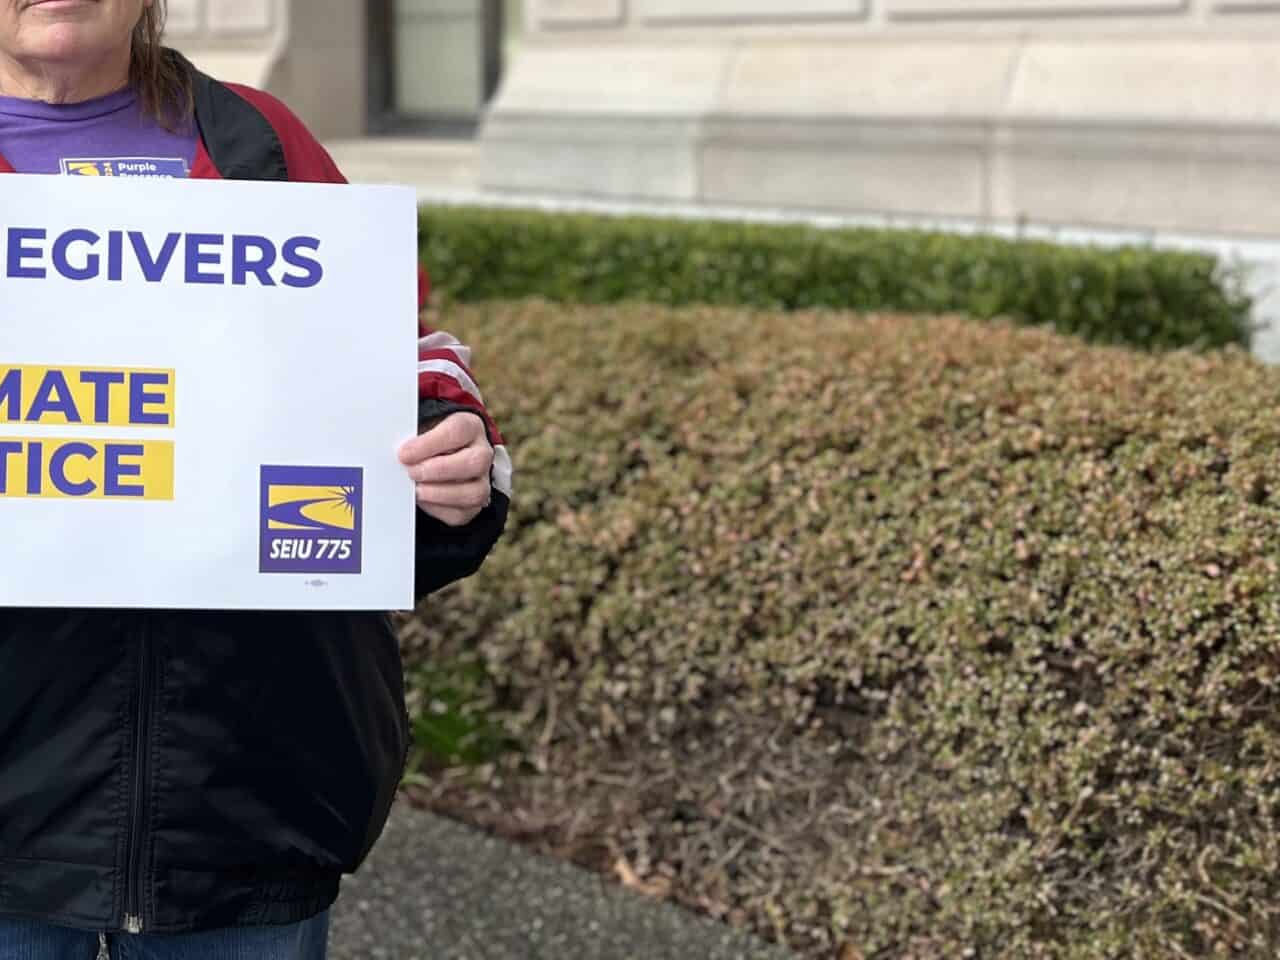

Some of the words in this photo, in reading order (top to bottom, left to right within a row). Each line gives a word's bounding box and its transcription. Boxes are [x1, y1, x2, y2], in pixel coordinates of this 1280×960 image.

[118, 162, 156, 172] Purple
[269, 539, 313, 559] SEIU
[315, 539, 352, 559] 775
